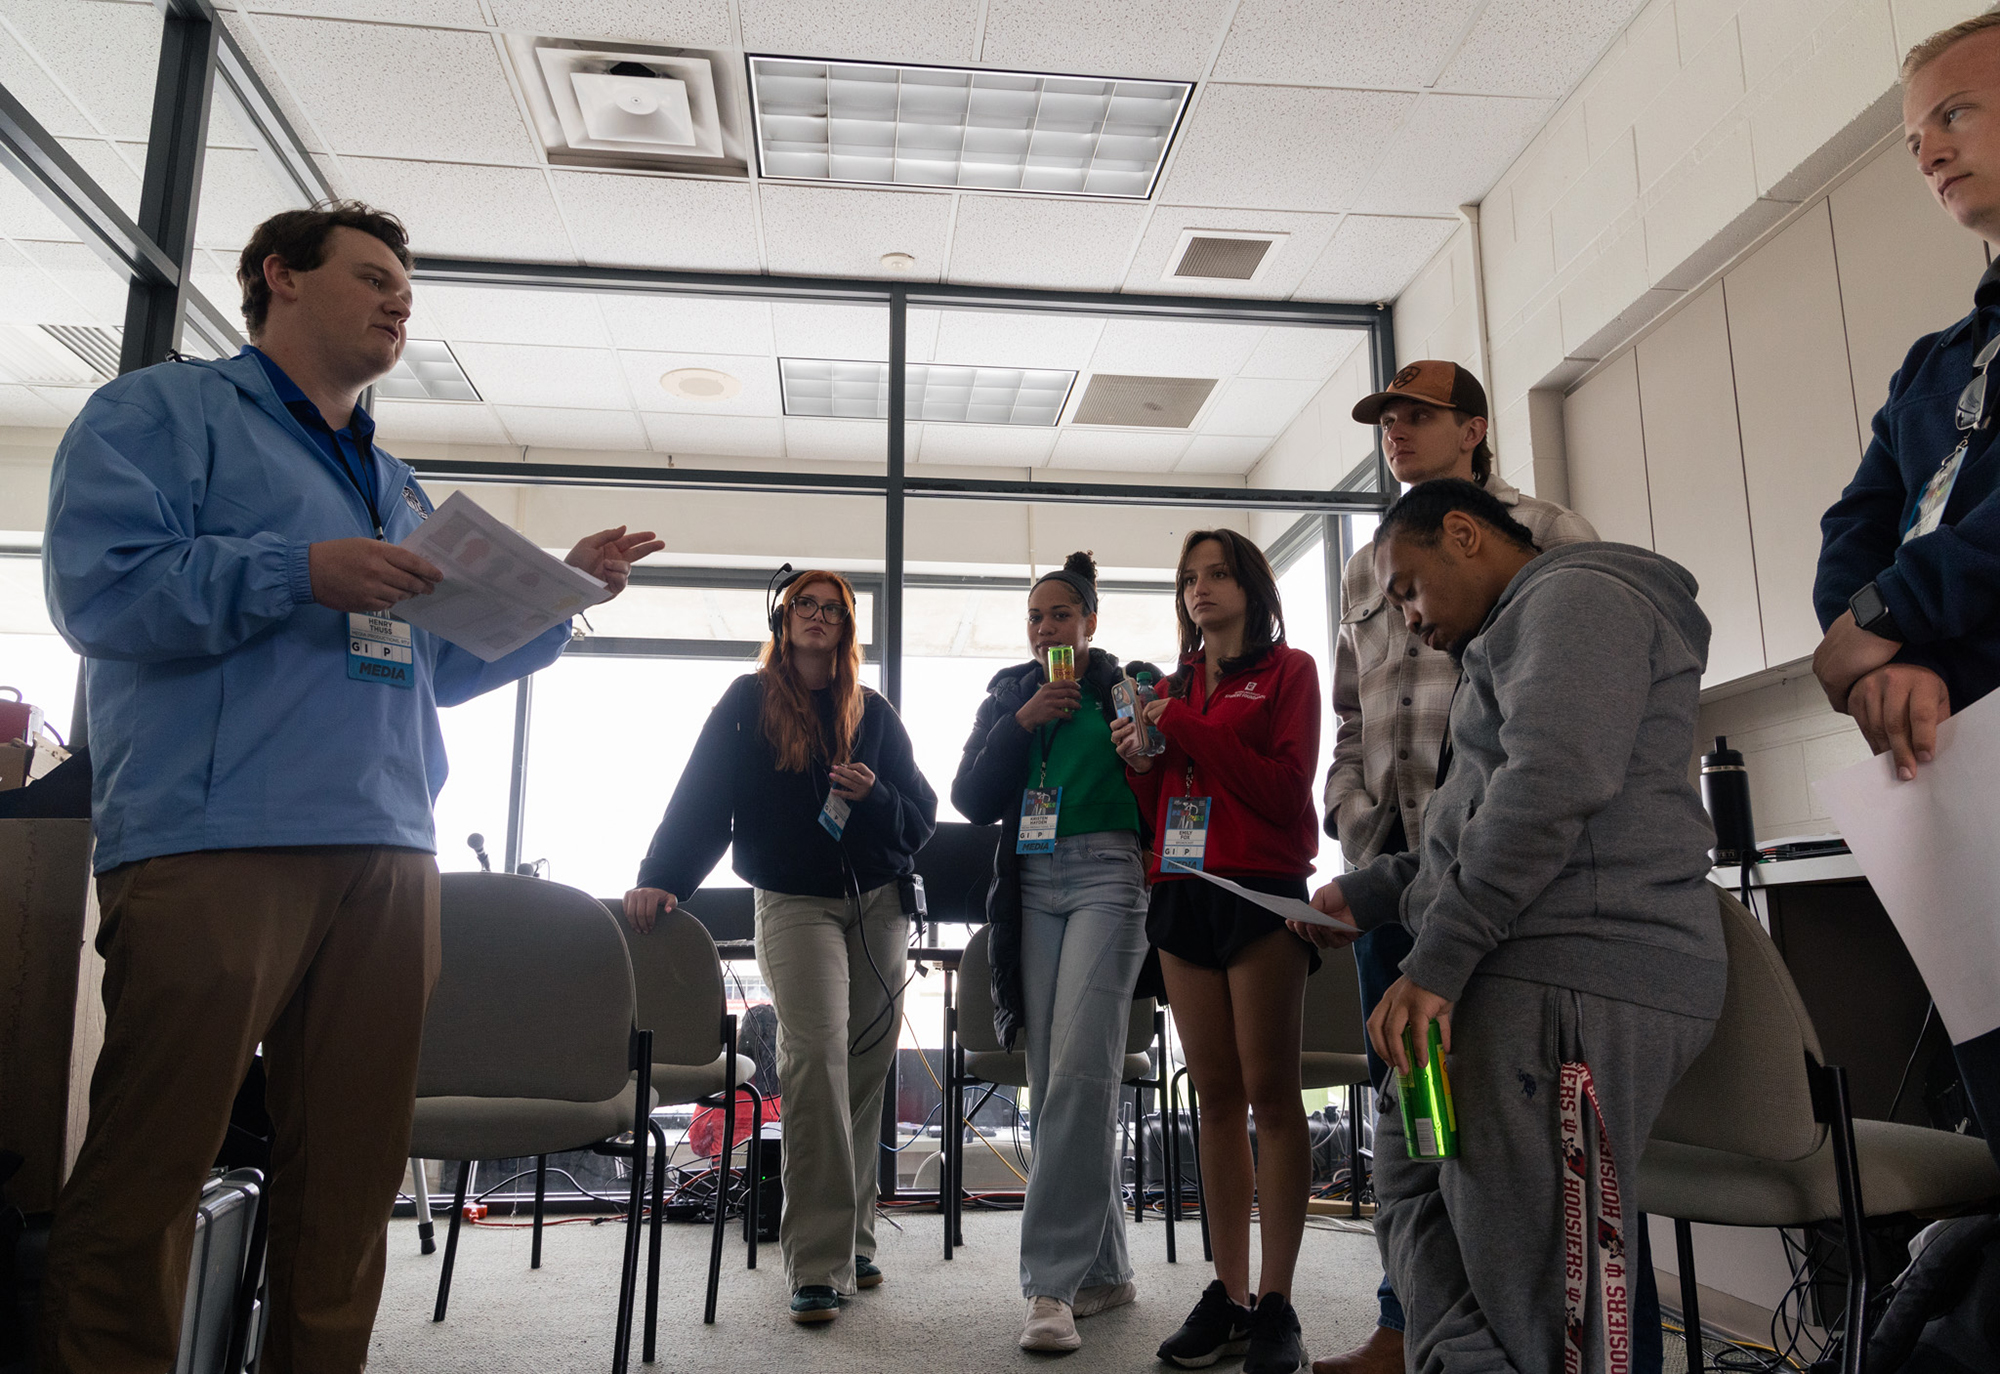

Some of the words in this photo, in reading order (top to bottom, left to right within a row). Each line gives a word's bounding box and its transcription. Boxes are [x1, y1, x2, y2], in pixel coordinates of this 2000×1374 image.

[368, 618, 392, 628] HENRY
[369, 625, 392, 635] THUSS
[351, 642, 360, 652] G
[365, 643, 368, 653] I
[383, 647, 391, 657] P
[359, 662, 406, 680] MEDIA
[1022, 842, 1049, 851] MEDIA
[1564, 1177, 1583, 1282] HOOSIERS
[1606, 1285, 1628, 1374] OOSIERS
